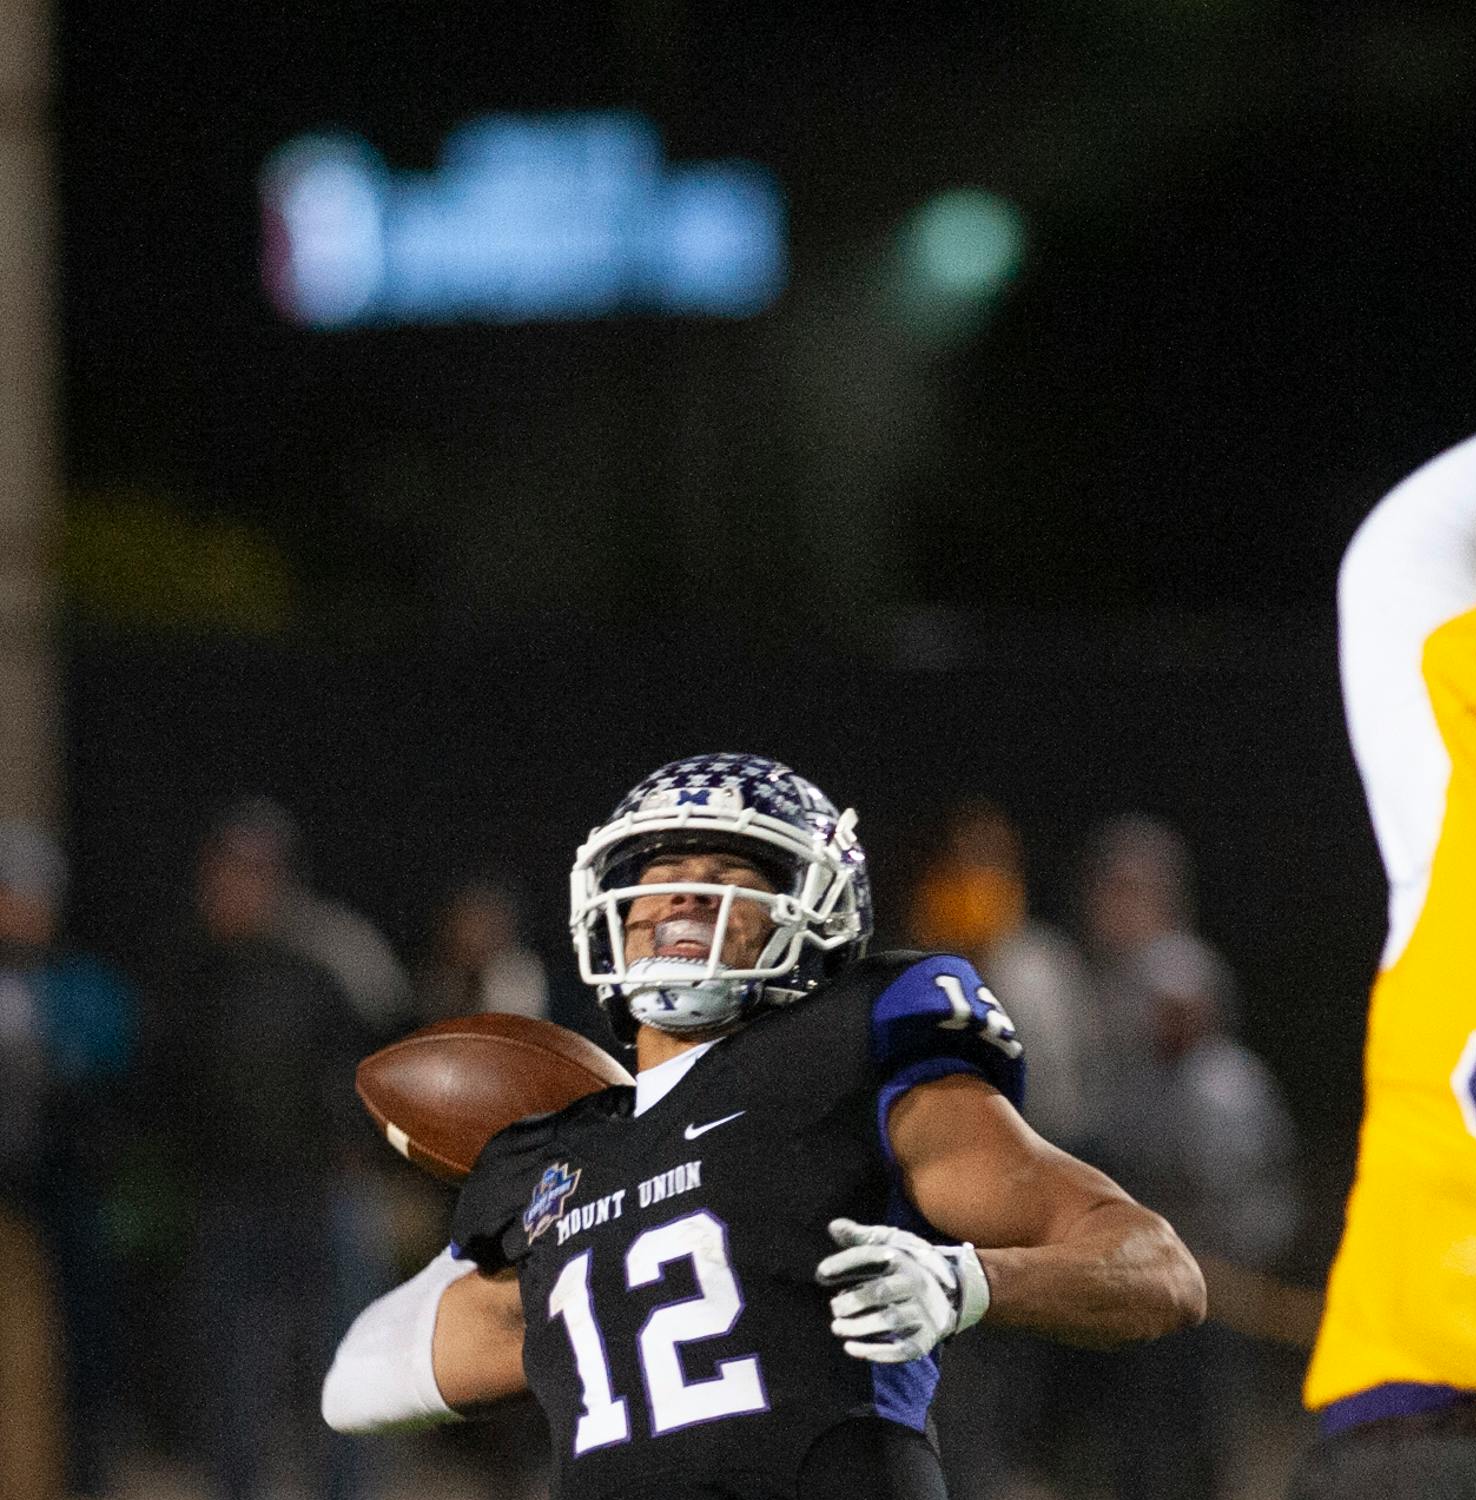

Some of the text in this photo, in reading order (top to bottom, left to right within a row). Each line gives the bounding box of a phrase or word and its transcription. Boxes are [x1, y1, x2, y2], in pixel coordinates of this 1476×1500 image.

[556, 1189, 626, 1246] MOUNT
[638, 1160, 702, 1209] UNION
[549, 1208, 771, 1459] 12
